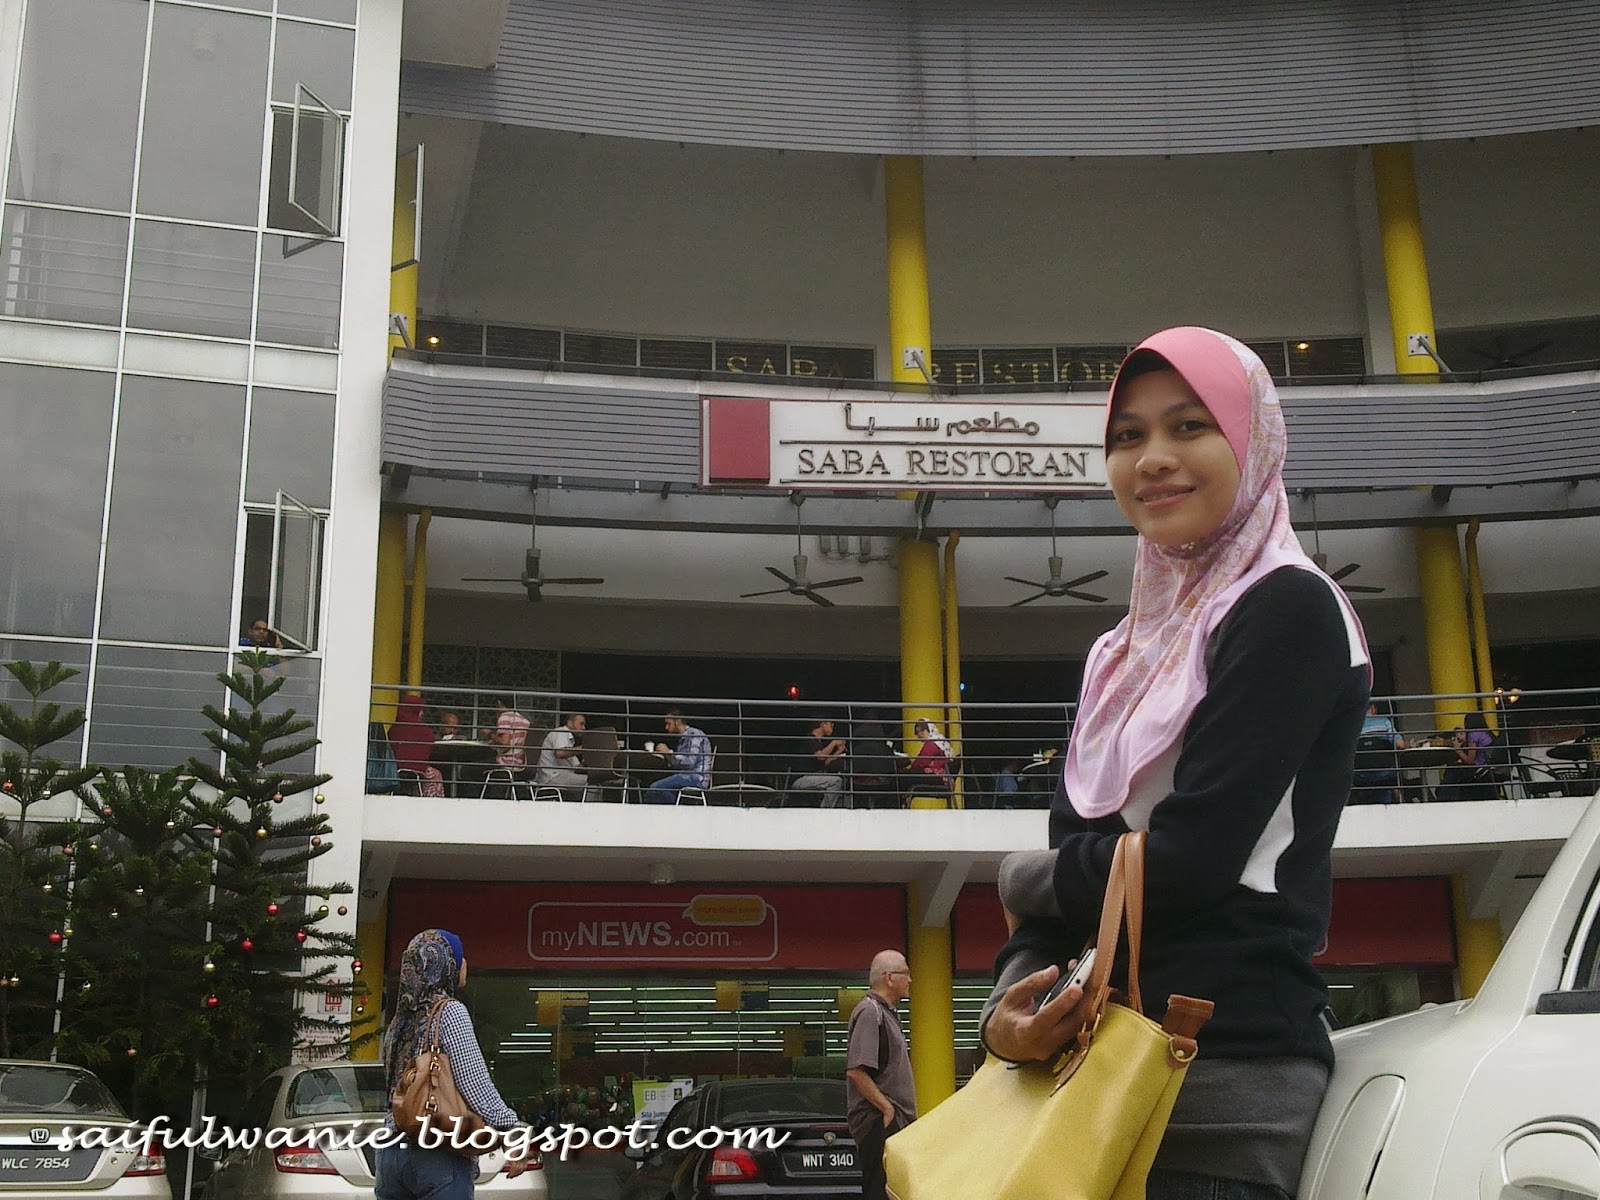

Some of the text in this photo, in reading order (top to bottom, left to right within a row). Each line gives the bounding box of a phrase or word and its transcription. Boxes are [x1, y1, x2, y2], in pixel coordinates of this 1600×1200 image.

[947, 411, 1040, 437] مطعم
[798, 449, 1090, 479] SABA RESTORAN
[542, 921, 730, 951] myNEWS.com
[645, 1090, 657, 1101] EB
[2, 1157, 71, 1169] WLC 7854
[802, 1153, 854, 1167] WNT 3140
